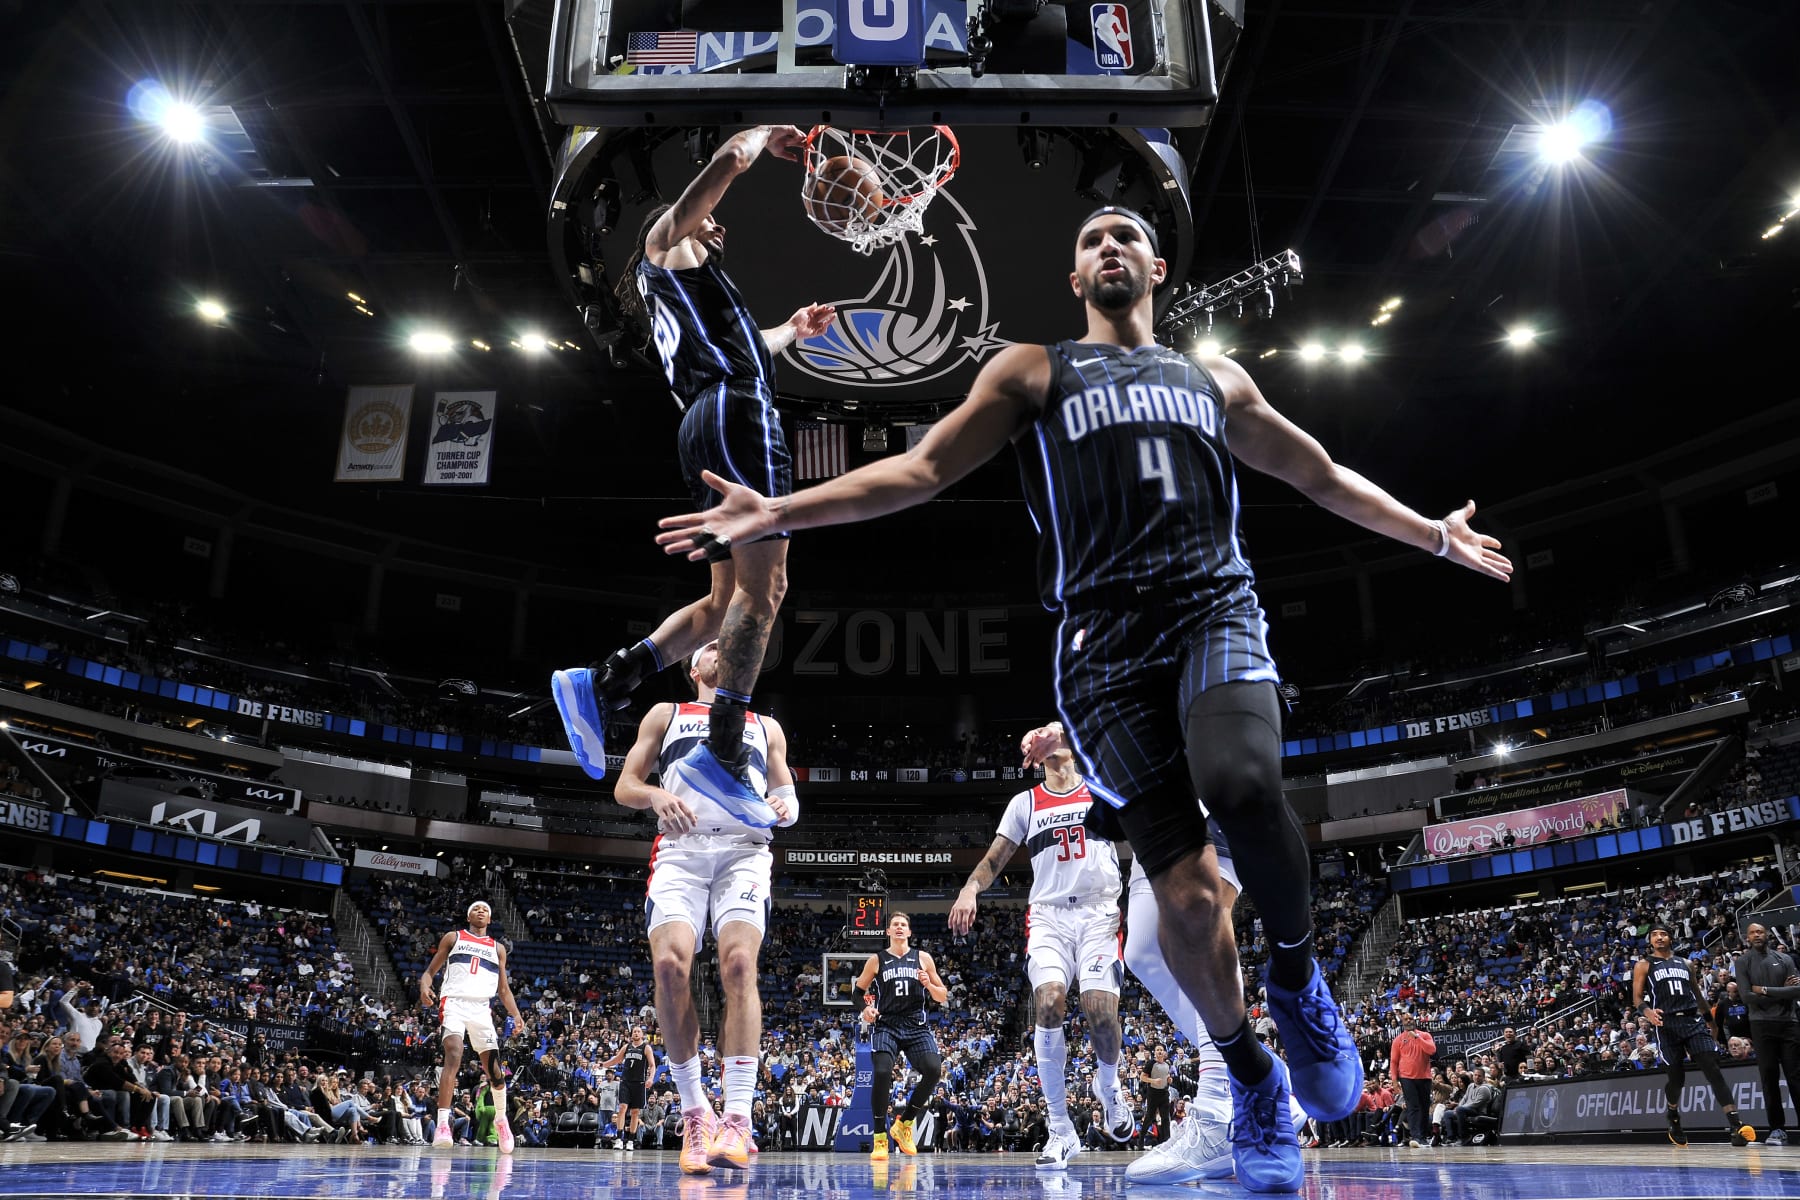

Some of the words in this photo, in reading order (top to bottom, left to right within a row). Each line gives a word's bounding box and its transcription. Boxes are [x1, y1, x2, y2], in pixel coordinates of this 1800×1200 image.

[1101, 53, 1119, 65] NBA
[1061, 384, 1218, 442] ORLANDO
[437, 451, 466, 461] TURNER
[466, 451, 481, 460] CUP
[347, 462, 374, 472] Amway
[436, 460, 479, 470] CHAMPIONS
[1138, 437, 1178, 500] 4
[440, 471, 473, 480] 2000-2001
[237, 698, 263, 718] DE
[267, 703, 323, 727] FENSE
[680, 720, 755, 740] wizs
[1406, 721, 1431, 739] DE
[1435, 709, 1490, 733] FENSE
[819, 770, 831, 780] 101
[851, 770, 868, 781] 6:41
[876, 770, 888, 780] 4TH
[906, 771, 920, 780] 120
[1018, 767, 1024, 779] 3
[150, 802, 262, 842] KIA
[1037, 806, 1091, 829] wizard
[1539, 812, 1585, 832] World
[1672, 820, 1707, 845] DE
[1709, 799, 1791, 836] FENSE
[1052, 824, 1087, 863] 33
[370, 853, 400, 870] Bally
[400, 861, 421, 870] SPORTS
[787, 852, 815, 863] BUD
[817, 852, 856, 863] LIGHT
[859, 852, 923, 863] BASELINE
[925, 852, 952, 863] BAR
[859, 897, 882, 908] 6:41
[855, 908, 880, 927] 21
[458, 943, 492, 958] wizards
[470, 956, 480, 975] 0
[882, 966, 919, 982] ORLANDO
[1654, 967, 1690, 982] ORLANDO
[895, 980, 909, 996] 21
[1667, 981, 1684, 995] 14
[270, 1028, 305, 1040] VEHICLE
[1433, 1034, 1464, 1044] FFICIAL
[1465, 1030, 1500, 1041] LUXURY
[1576, 1090, 1642, 1118] OFFICIAL
[1645, 1085, 1716, 1114] LUURY
